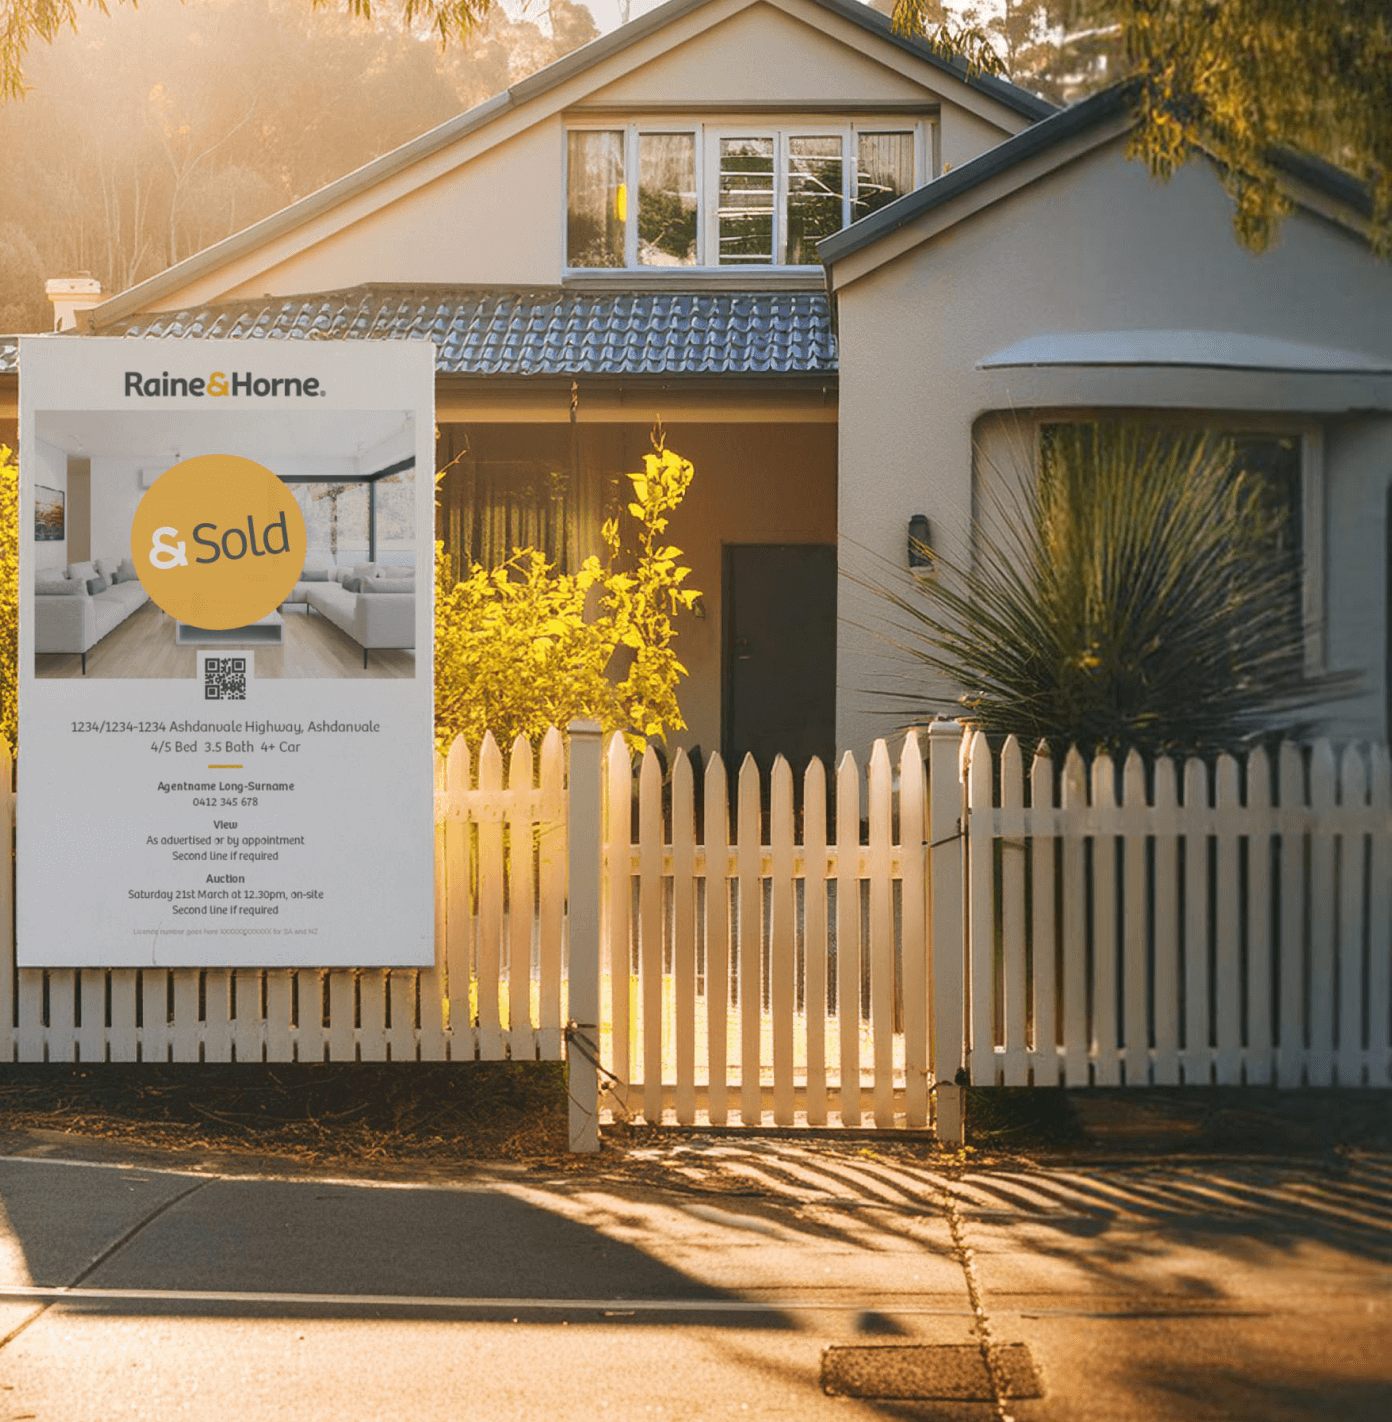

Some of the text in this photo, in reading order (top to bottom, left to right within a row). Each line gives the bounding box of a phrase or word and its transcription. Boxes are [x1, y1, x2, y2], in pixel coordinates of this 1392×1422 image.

[149, 510, 291, 570] & Sold
[71, 719, 381, 735] 1234/1234-1234 Ashdanvale Highway, Ashdanvale
[150, 740, 301, 754] 4/5 Bed 3.5 Bath 4+ Car
[157, 781, 295, 794] Agentname Long-Surname
[192, 797, 259, 807] 0412 345 678
[213, 820, 238, 830] View
[146, 835, 305, 848] As advertised or by appointment
[172, 850, 279, 863] Second line if required
[205, 873, 246, 884] Auction
[128, 889, 324, 902] Saturday 21st March at 12.30pm, on-site
[172, 904, 279, 917] Second line if required
